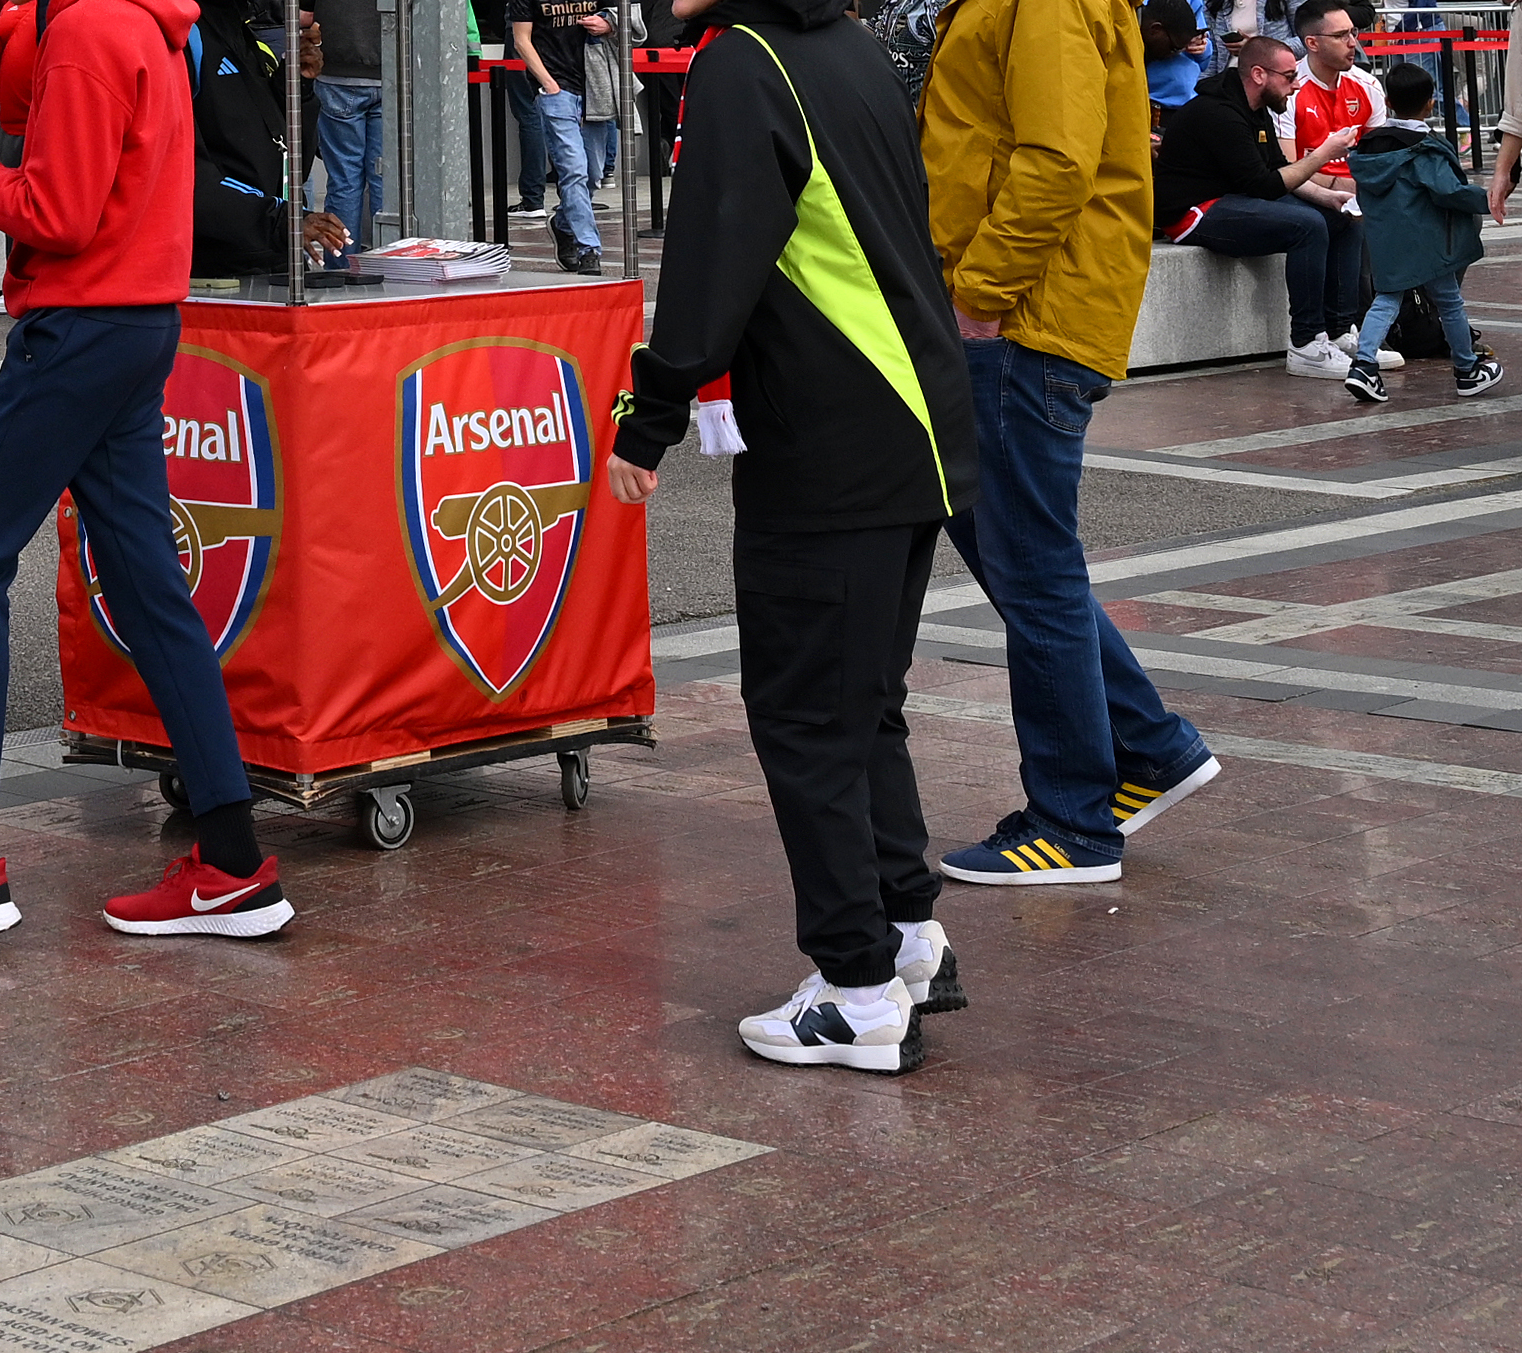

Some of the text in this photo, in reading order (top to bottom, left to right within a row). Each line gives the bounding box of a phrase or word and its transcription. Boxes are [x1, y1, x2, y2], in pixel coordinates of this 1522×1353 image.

[540, 0, 598, 16] Emirates
[552, 16, 565, 28] FLY
[162, 407, 242, 463] enal
[424, 389, 566, 458] Arsenal
[55, 1321, 137, 1347] BOWLES
